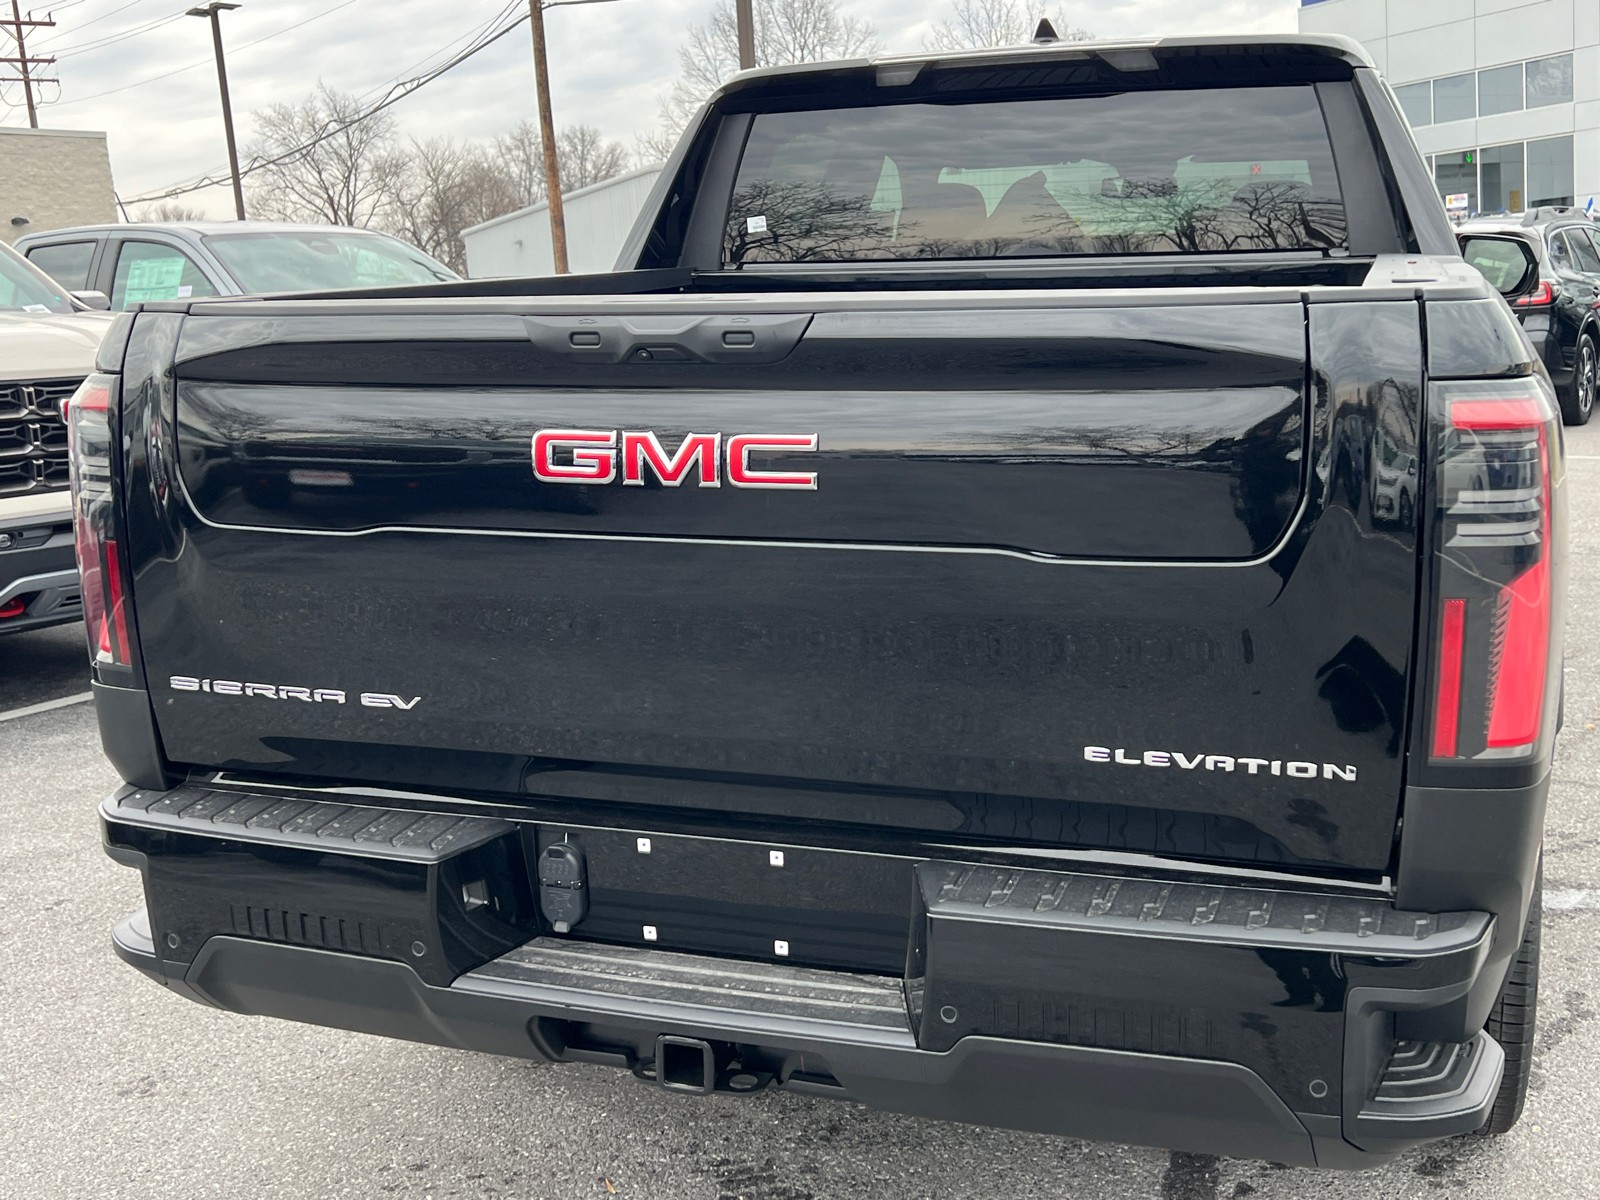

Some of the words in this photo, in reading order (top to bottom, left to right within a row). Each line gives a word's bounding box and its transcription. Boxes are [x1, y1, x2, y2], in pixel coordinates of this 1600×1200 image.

[532, 429, 818, 490] GMC
[169, 675, 346, 704] SIERRA
[360, 692, 422, 710] EV
[1083, 745, 1357, 782] ELEVATION
